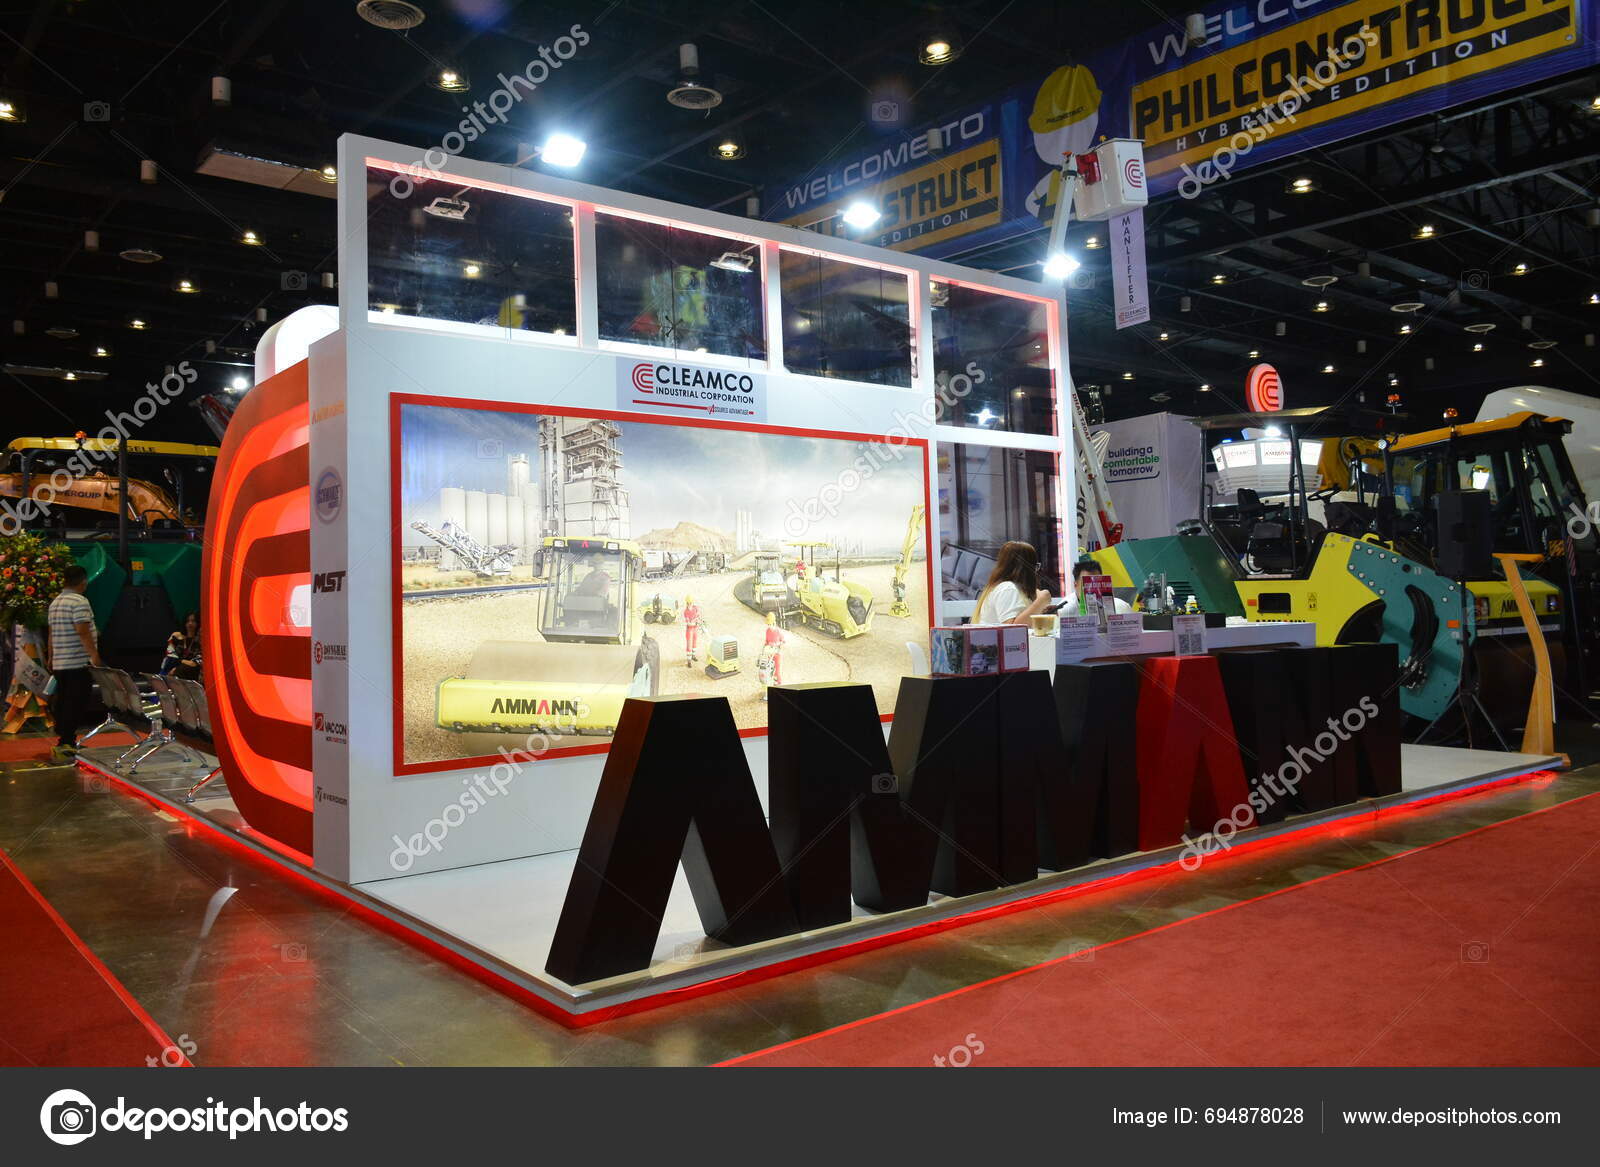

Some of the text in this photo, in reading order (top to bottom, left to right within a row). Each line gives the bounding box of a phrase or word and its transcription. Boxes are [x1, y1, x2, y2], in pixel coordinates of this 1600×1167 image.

[1136, 0, 1556, 139] PHILCONSTRU
[1331, 29, 1507, 100] EDITION
[785, 112, 984, 208] WELCOME TO
[881, 209, 968, 247] EDITION
[1121, 216, 1135, 304] MANLIFTER
[655, 365, 753, 393] CLEAMCO
[655, 386, 754, 405] INDUSTRIAL CORPORATION
[1103, 455, 1160, 469] comfortable
[1108, 446, 1153, 458] building a
[1109, 466, 1153, 477] tomorrow
[313, 571, 346, 593] MST
[490, 698, 578, 716] AMMANN
[545, 642, 1402, 985] AMMANN
